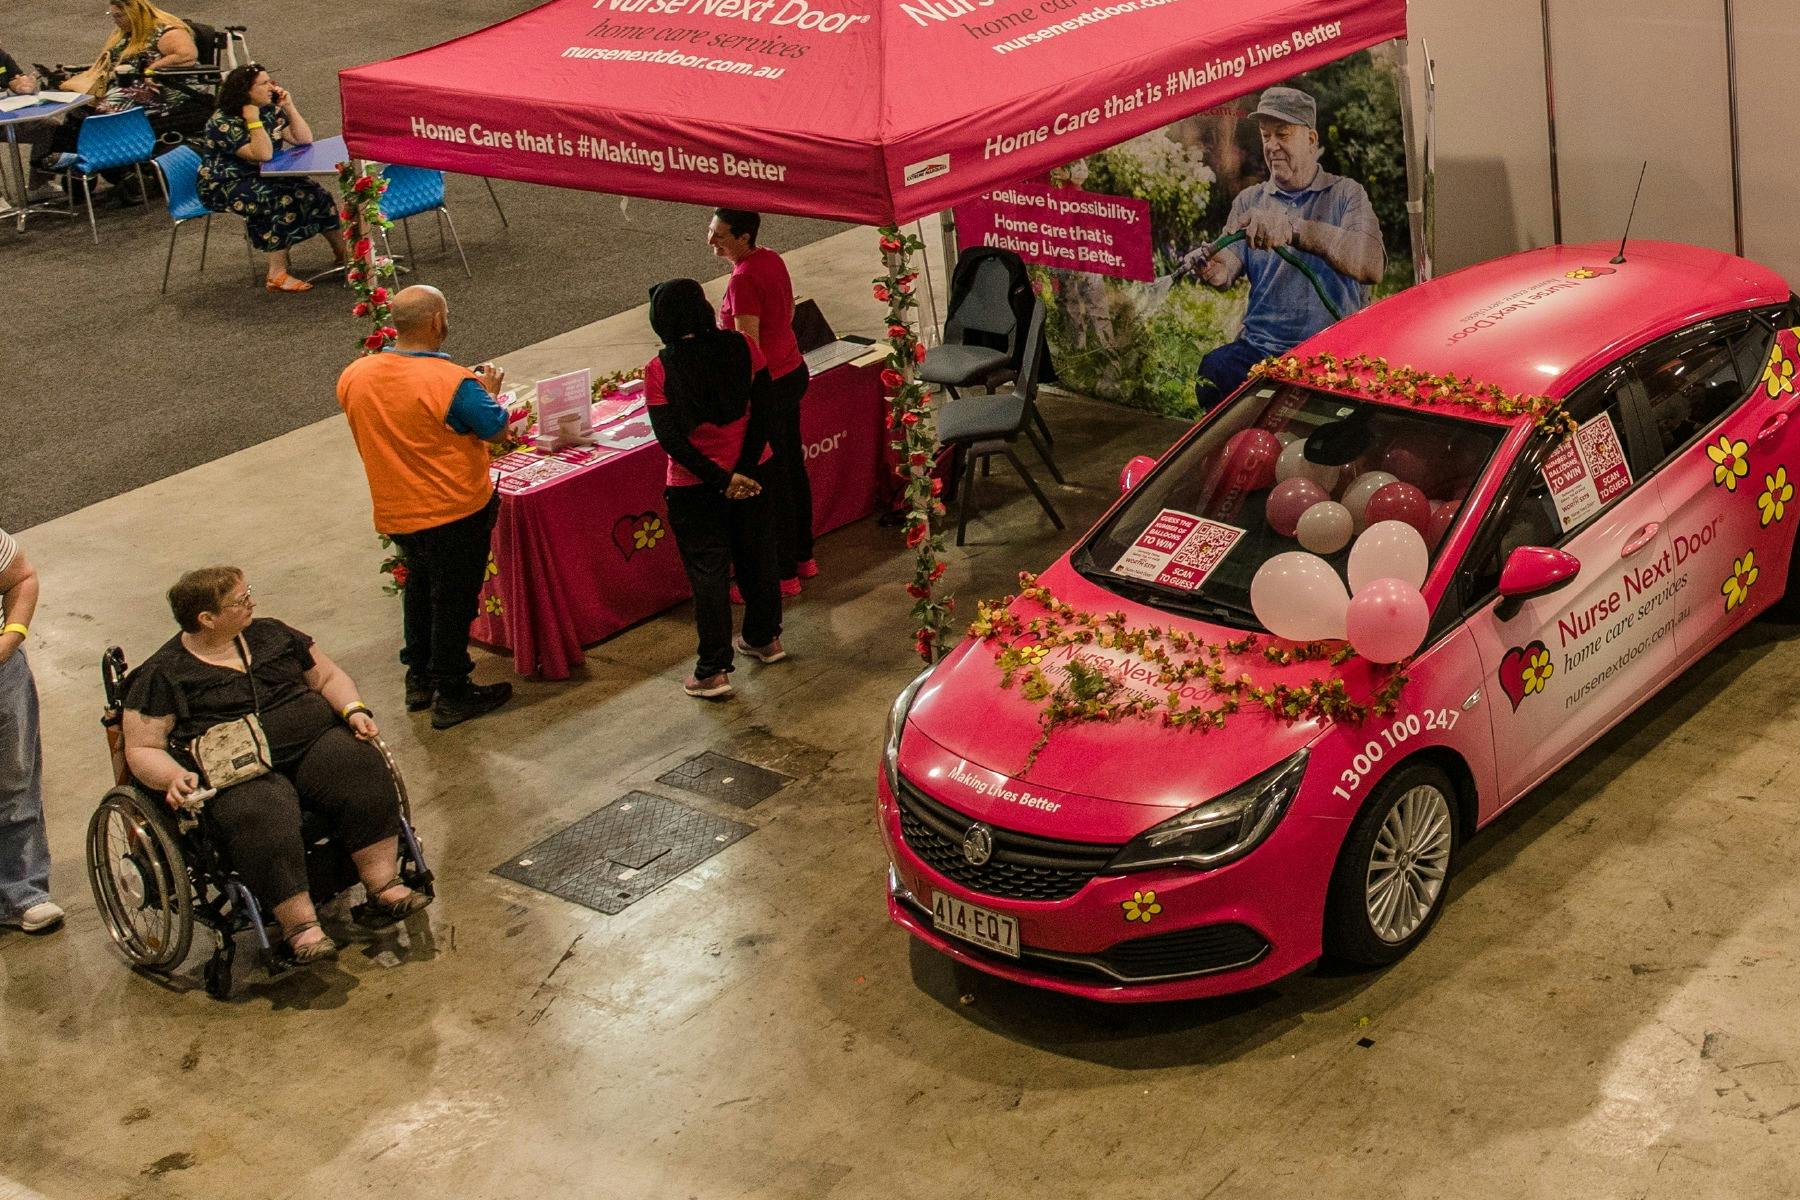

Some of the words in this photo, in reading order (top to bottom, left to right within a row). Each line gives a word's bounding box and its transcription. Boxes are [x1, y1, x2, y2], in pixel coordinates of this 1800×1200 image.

[586, 18, 656, 41] home
[658, 25, 711, 49] care
[710, 29, 811, 60] services
[561, 45, 787, 81] nursenextdoor.com.au
[410, 116, 467, 145] Home
[469, 122, 513, 150] Care
[516, 129, 555, 156] that
[557, 135, 574, 157] is
[577, 135, 665, 174] #Making
[668, 147, 720, 177] Lives
[723, 153, 788, 183] Better
[994, 213, 1038, 234] Home
[1040, 225, 1067, 241] care
[1069, 227, 1098, 243] that
[1100, 230, 1113, 246] is
[983, 232, 1039, 256] Making
[1042, 240, 1076, 260] Lives
[1077, 247, 1126, 268] Better.
[1160, 514, 1180, 525] GUESS
[1180, 519, 1192, 527] THE
[1143, 535, 1155, 544] TO
[1156, 540, 1175, 550] WIN
[1160, 573, 1170, 582] TO
[1170, 576, 1195, 589] GUESS
[1172, 567, 1194, 579] SCAN
[1558, 591, 1621, 648] Nurse
[1623, 550, 1672, 602] Next
[948, 766, 988, 794] Making
[987, 784, 1018, 801] Lives
[1019, 793, 1062, 813] Better
